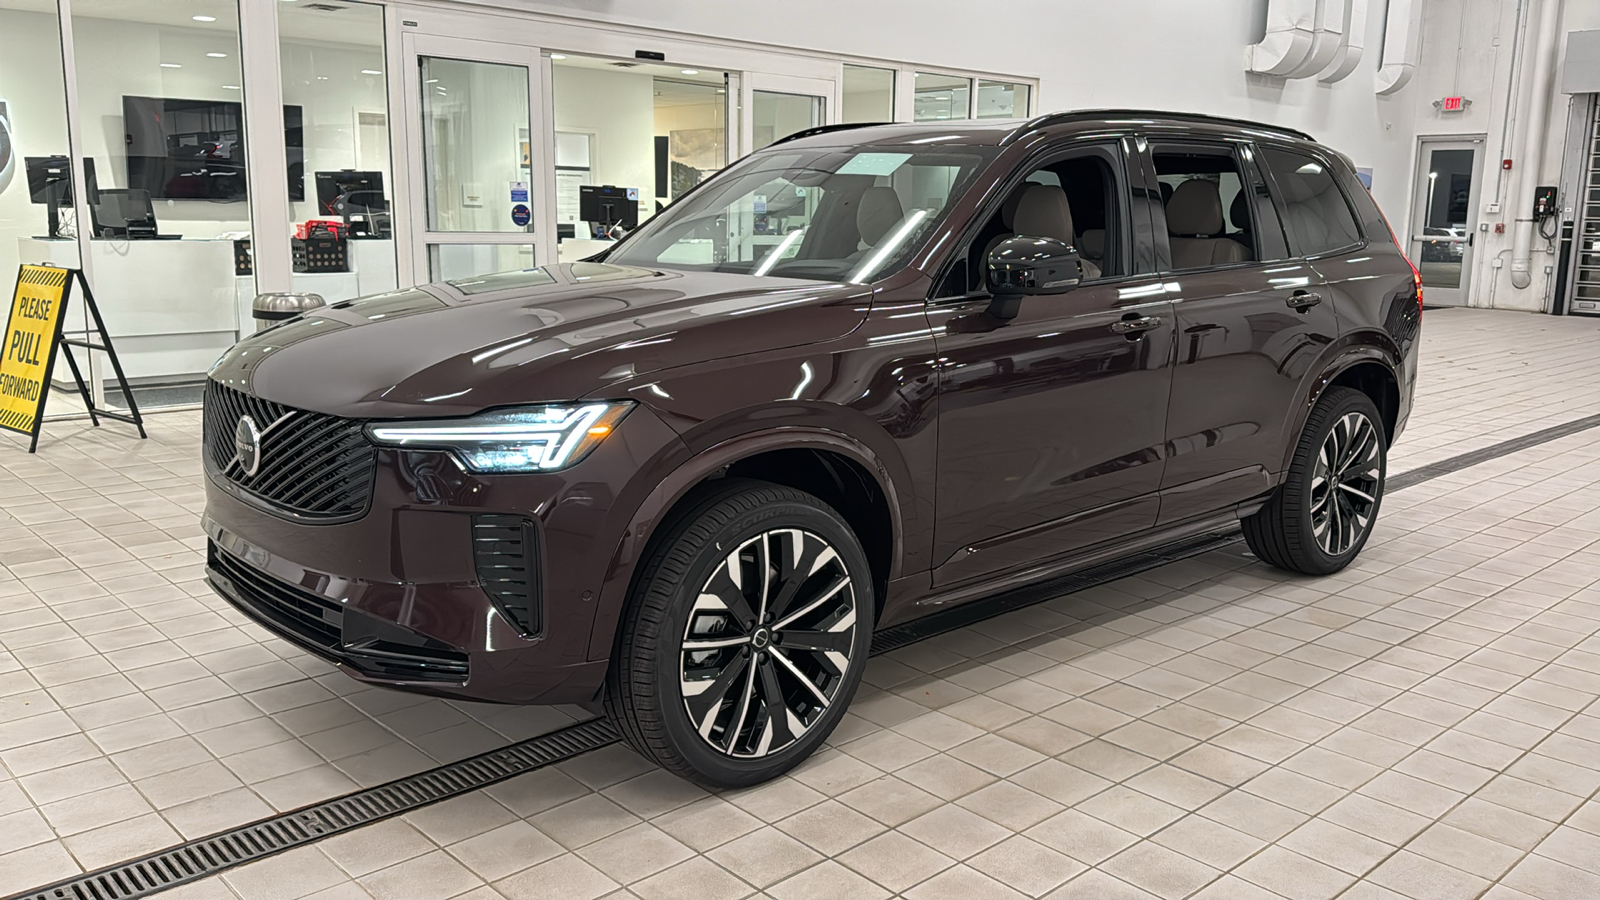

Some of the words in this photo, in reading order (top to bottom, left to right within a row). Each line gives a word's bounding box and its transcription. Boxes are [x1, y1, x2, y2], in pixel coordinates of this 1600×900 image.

[1445, 97, 1462, 110] EXIT
[18, 296, 52, 321] PLEASE
[8, 329, 41, 365] PULL
[0, 373, 40, 402] FORWARD
